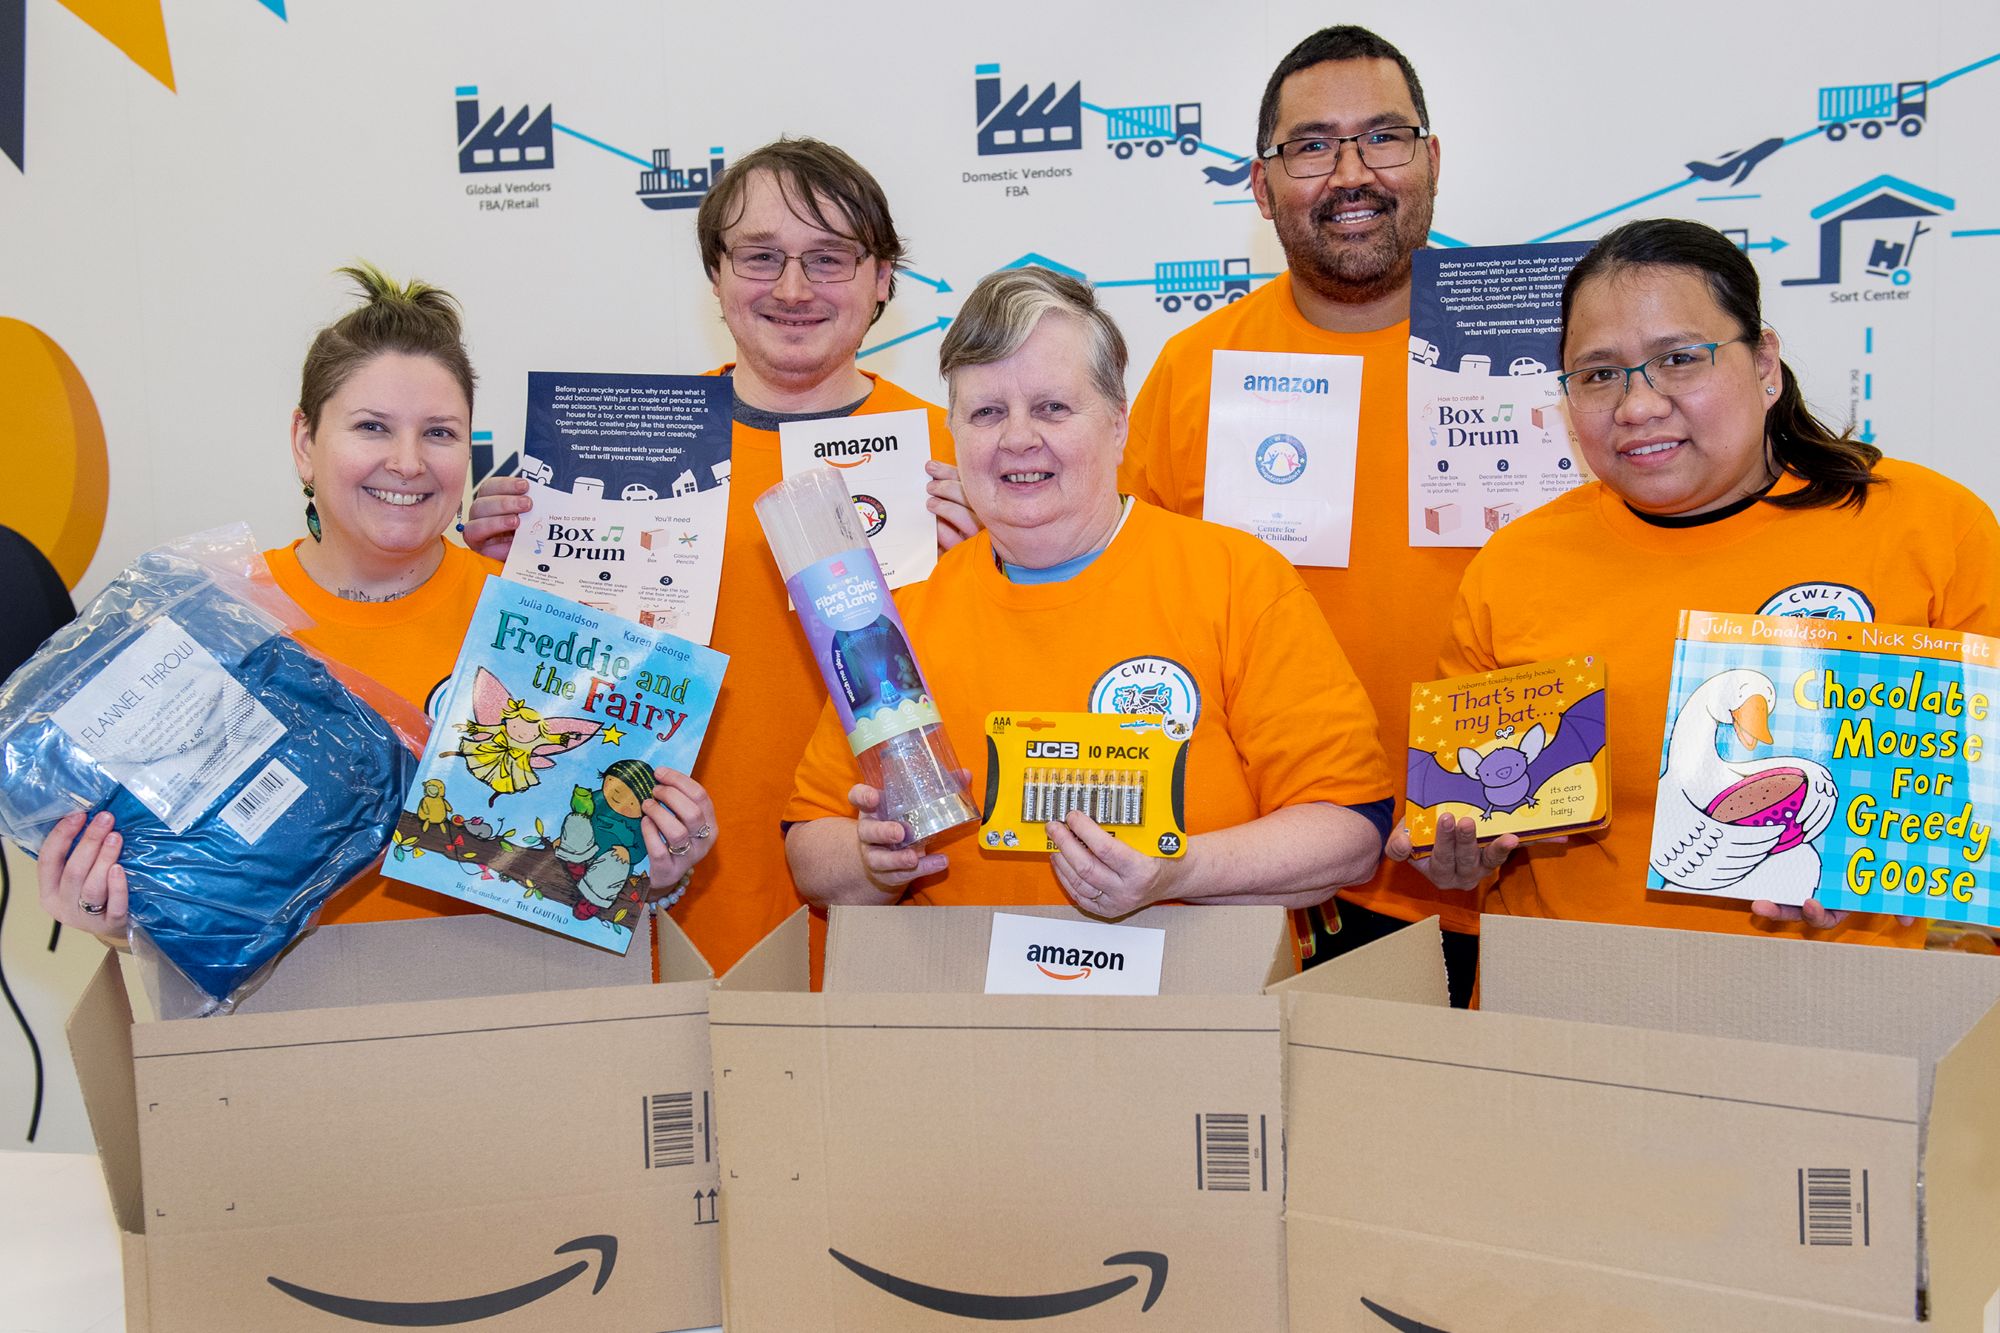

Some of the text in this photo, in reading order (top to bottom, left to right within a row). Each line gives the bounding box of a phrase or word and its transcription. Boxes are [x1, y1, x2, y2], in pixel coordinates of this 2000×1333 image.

[962, 168, 1072, 183] Domestic Vendors
[466, 183, 551, 195] Global Vendors
[1006, 187, 1029, 197] FBA
[480, 199, 539, 211] FBA/Retail
[1830, 290, 1910, 303] Sort Center
[645, 388, 658, 396] why
[1243, 375, 1329, 394] amazon
[619, 396, 631, 404] just
[556, 419, 598, 427] Open-ended,
[1439, 406, 1485, 425] Box
[601, 429, 652, 438] problem-solving
[1448, 428, 1519, 447] Drum
[814, 435, 898, 458] amazon
[548, 524, 595, 541] Box
[1257, 525, 1296, 534] Centre for
[1266, 533, 1308, 542] Childhood
[552, 543, 625, 561] Drum
[815, 579, 877, 610] Fibre Optic
[1789, 588, 1842, 604] CWL1
[519, 596, 599, 630] Julia Donaldson
[825, 603, 845, 618] Ice
[844, 591, 877, 608] Lamp
[623, 630, 691, 662] Karen George
[1700, 617, 1990, 658] Julia Donaldson Nick Sharratt
[490, 609, 691, 705] Freddie and
[835, 650, 855, 703] watch me glow!
[1121, 663, 1167, 677] CWL1
[1458, 668, 1556, 691] Usborne touchy-feely books
[81, 689, 145, 744] FLANNEL
[139, 641, 194, 689] THROW
[1448, 678, 1564, 712] That's not
[1793, 669, 1989, 721] Chocolate
[532, 662, 688, 743] the Fairy
[993, 717, 1011, 726] AAA
[1455, 704, 1553, 734] my bat...
[1832, 718, 1984, 762] Mousse
[1027, 743, 1078, 758] JCB
[1089, 746, 1149, 759] 10 PACK
[1891, 768, 1953, 799] For
[1550, 808, 1575, 817] hairy.
[1846, 793, 1992, 862] Greedy
[1847, 847, 1976, 903] Goose
[456, 882, 466, 891] By
[467, 886, 477, 894] the
[478, 890, 501, 902] author
[1026, 944, 1124, 971] amazon
